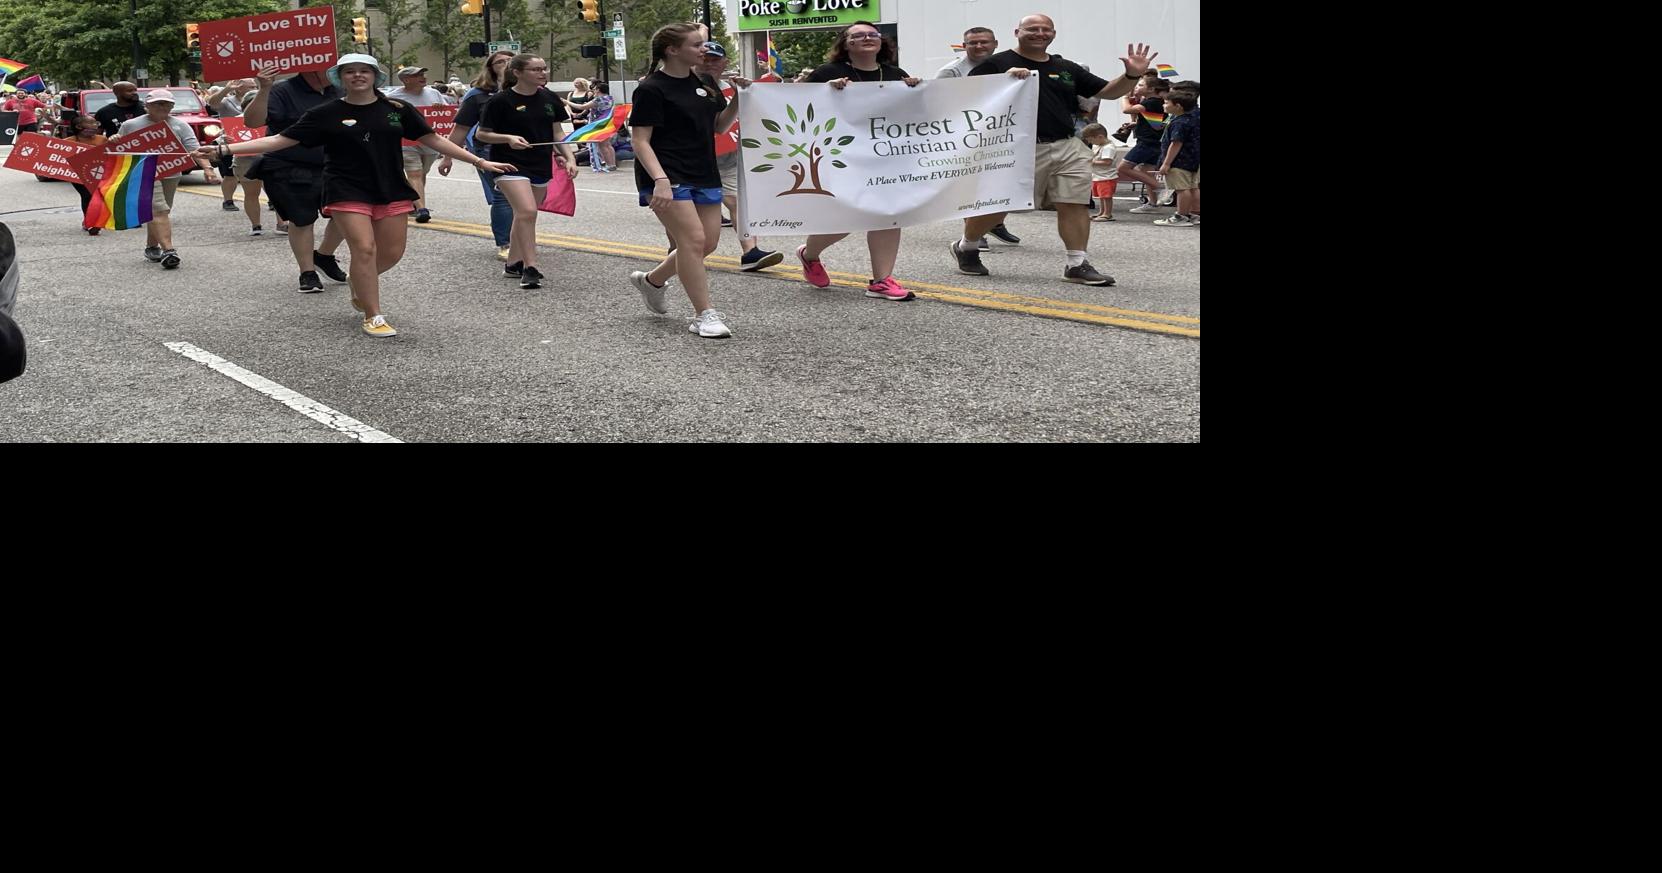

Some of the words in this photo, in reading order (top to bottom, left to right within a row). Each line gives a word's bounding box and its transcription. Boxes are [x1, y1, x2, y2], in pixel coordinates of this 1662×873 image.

[739, 0, 780, 17] Poke
[248, 19, 290, 33] Love
[294, 13, 328, 28] Thy
[769, 18, 790, 27] SUSHI
[792, 15, 838, 25] REINVENTED
[249, 35, 331, 53] Indigenous
[250, 52, 333, 71] Neighbor
[423, 109, 452, 117] Love
[431, 121, 456, 129] Jew
[868, 116, 955, 140] Forest
[961, 104, 1017, 132] Park
[140, 127, 167, 142] Thy
[873, 138, 956, 157] Christian
[963, 128, 1014, 149] Church
[46, 139, 73, 152] Love
[917, 155, 971, 168] Growing
[973, 149, 1015, 162] Christians
[33, 162, 80, 179] Neighbo
[866, 178, 874, 187] A
[875, 175, 897, 186] Place
[899, 173, 929, 184] Where
[930, 166, 978, 181] EVERYONE
[759, 218, 771, 227] &
[771, 219, 803, 229] Mingo
